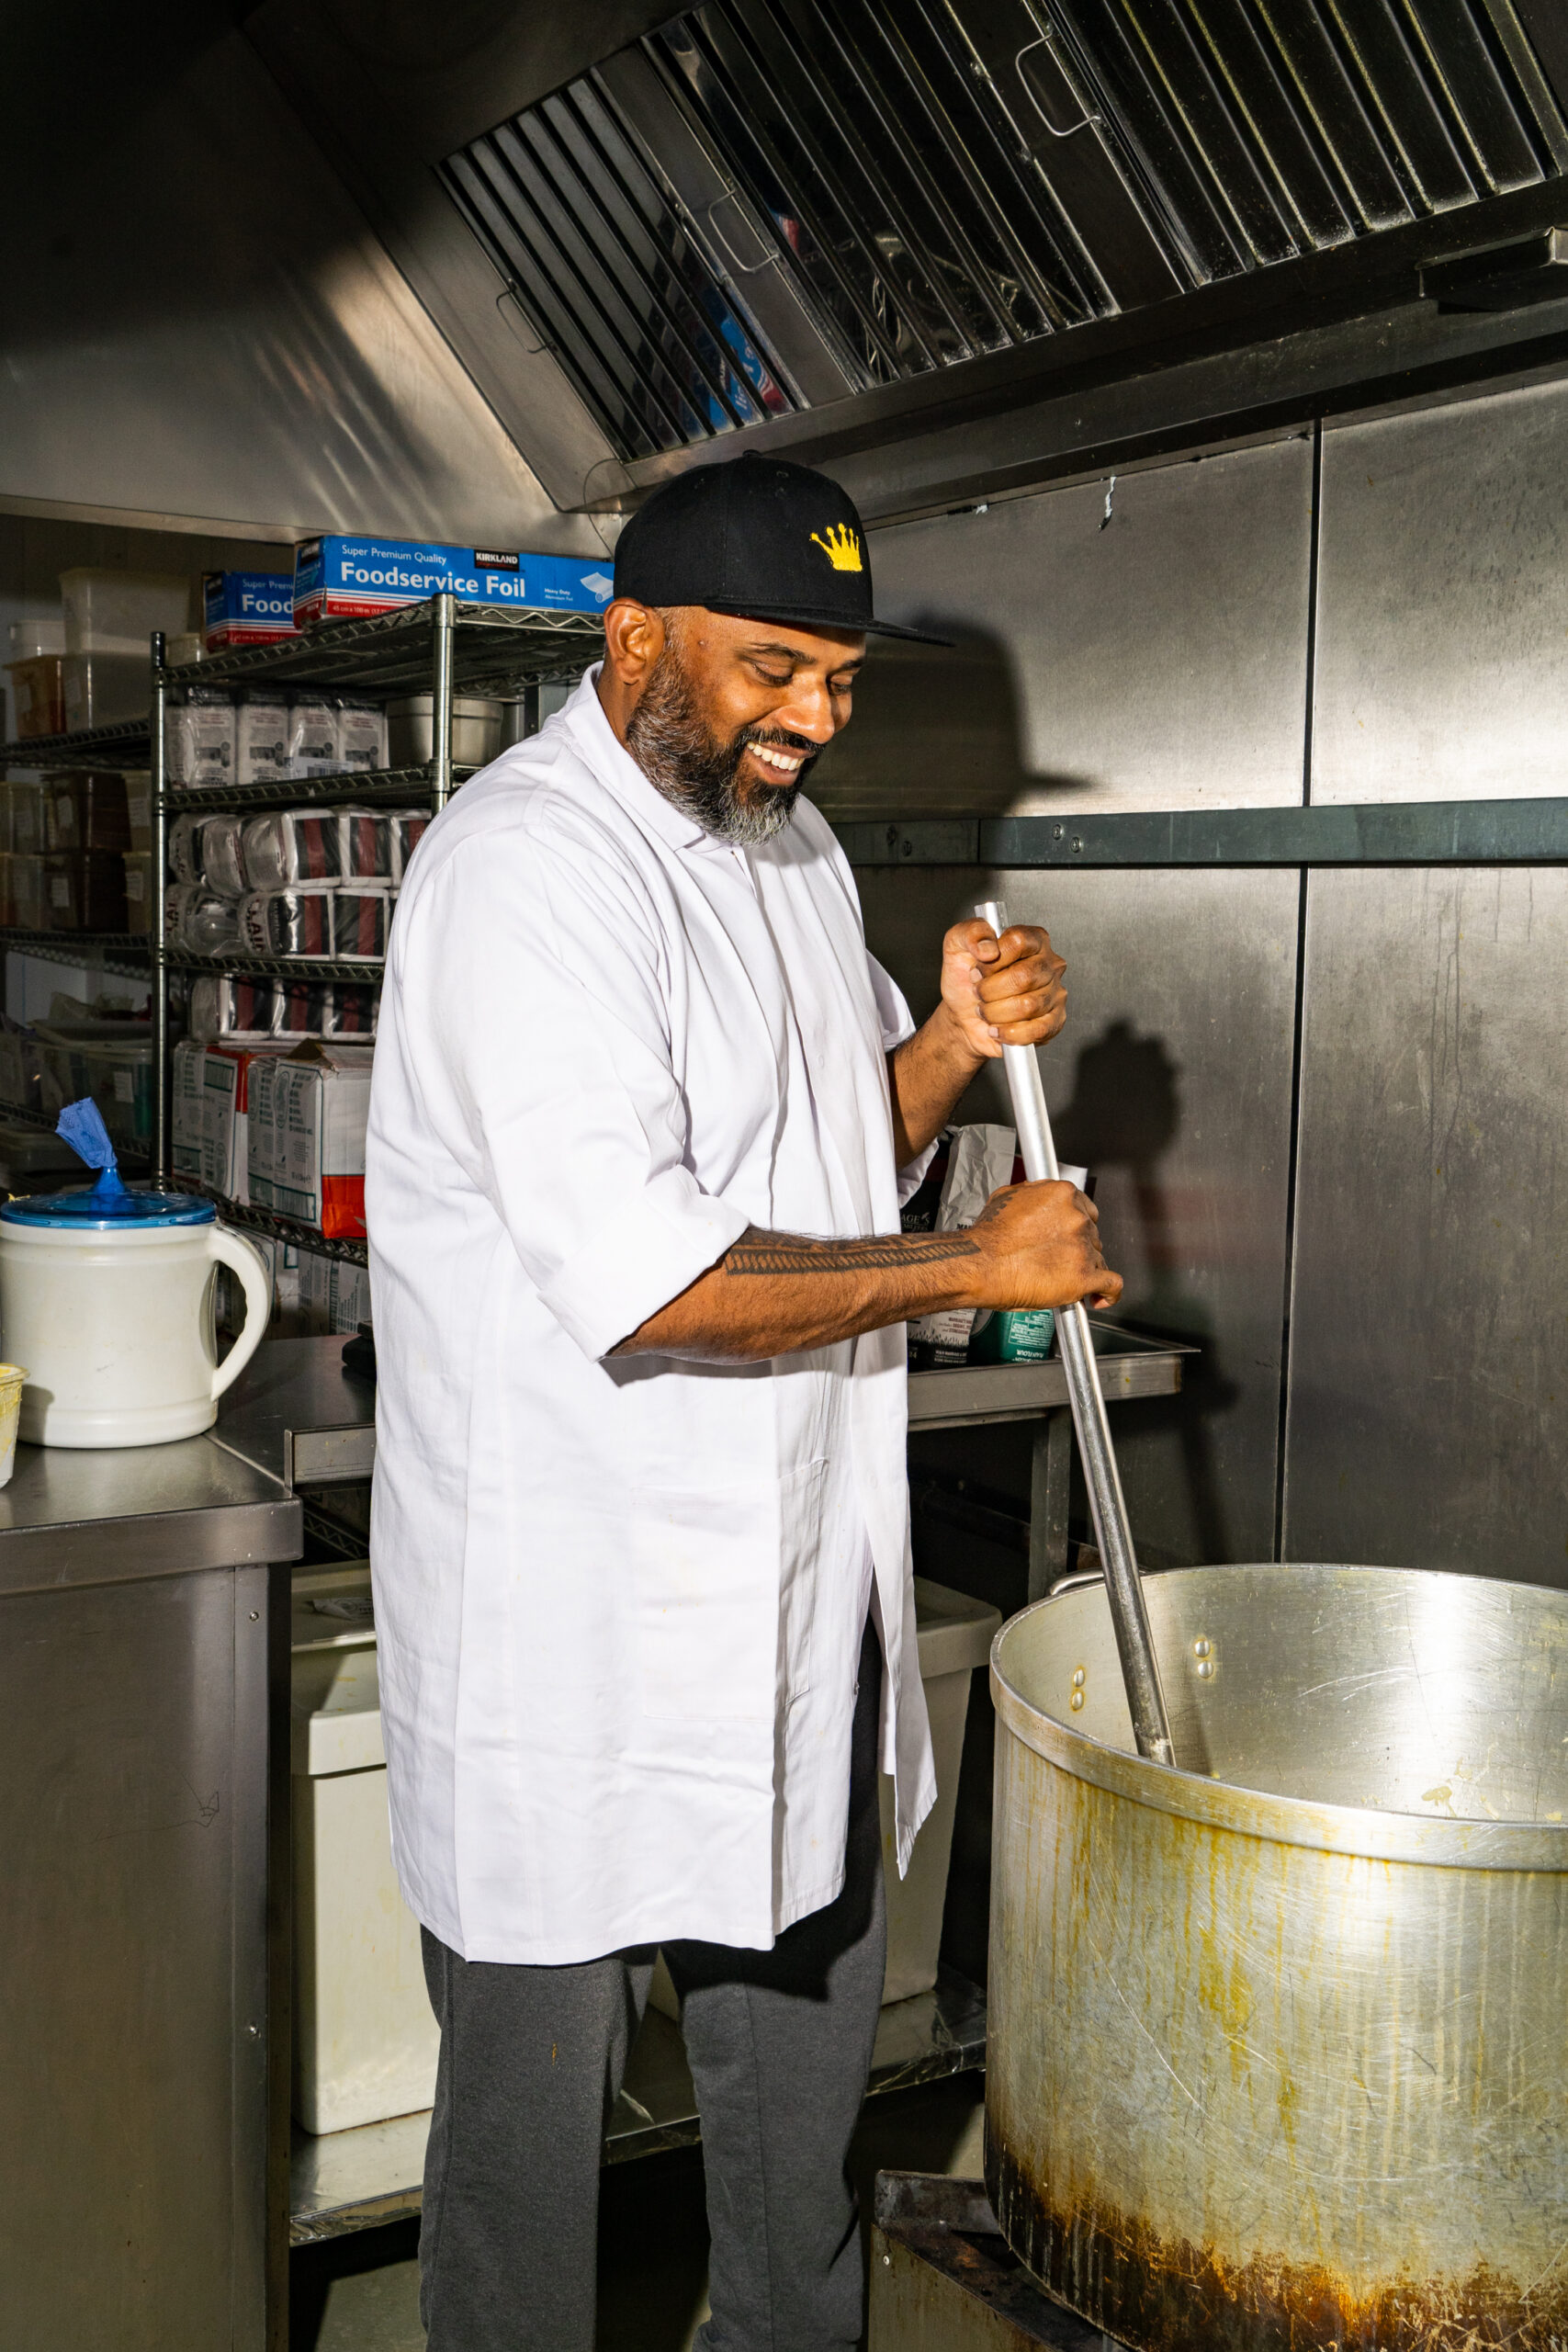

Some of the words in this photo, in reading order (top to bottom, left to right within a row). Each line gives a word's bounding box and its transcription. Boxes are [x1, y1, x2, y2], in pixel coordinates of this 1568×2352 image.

[341, 544, 368, 558] Super
[371, 548, 412, 560] Premium
[413, 551, 447, 566] Quality
[475, 551, 518, 564] KIRKLAND
[242, 578, 265, 590] Super
[268, 580, 294, 590] Premi
[341, 561, 479, 594] Foodservice
[486, 575, 525, 598] Foil
[242, 594, 294, 615] Food
[901, 1213, 931, 1224] AGE'S
